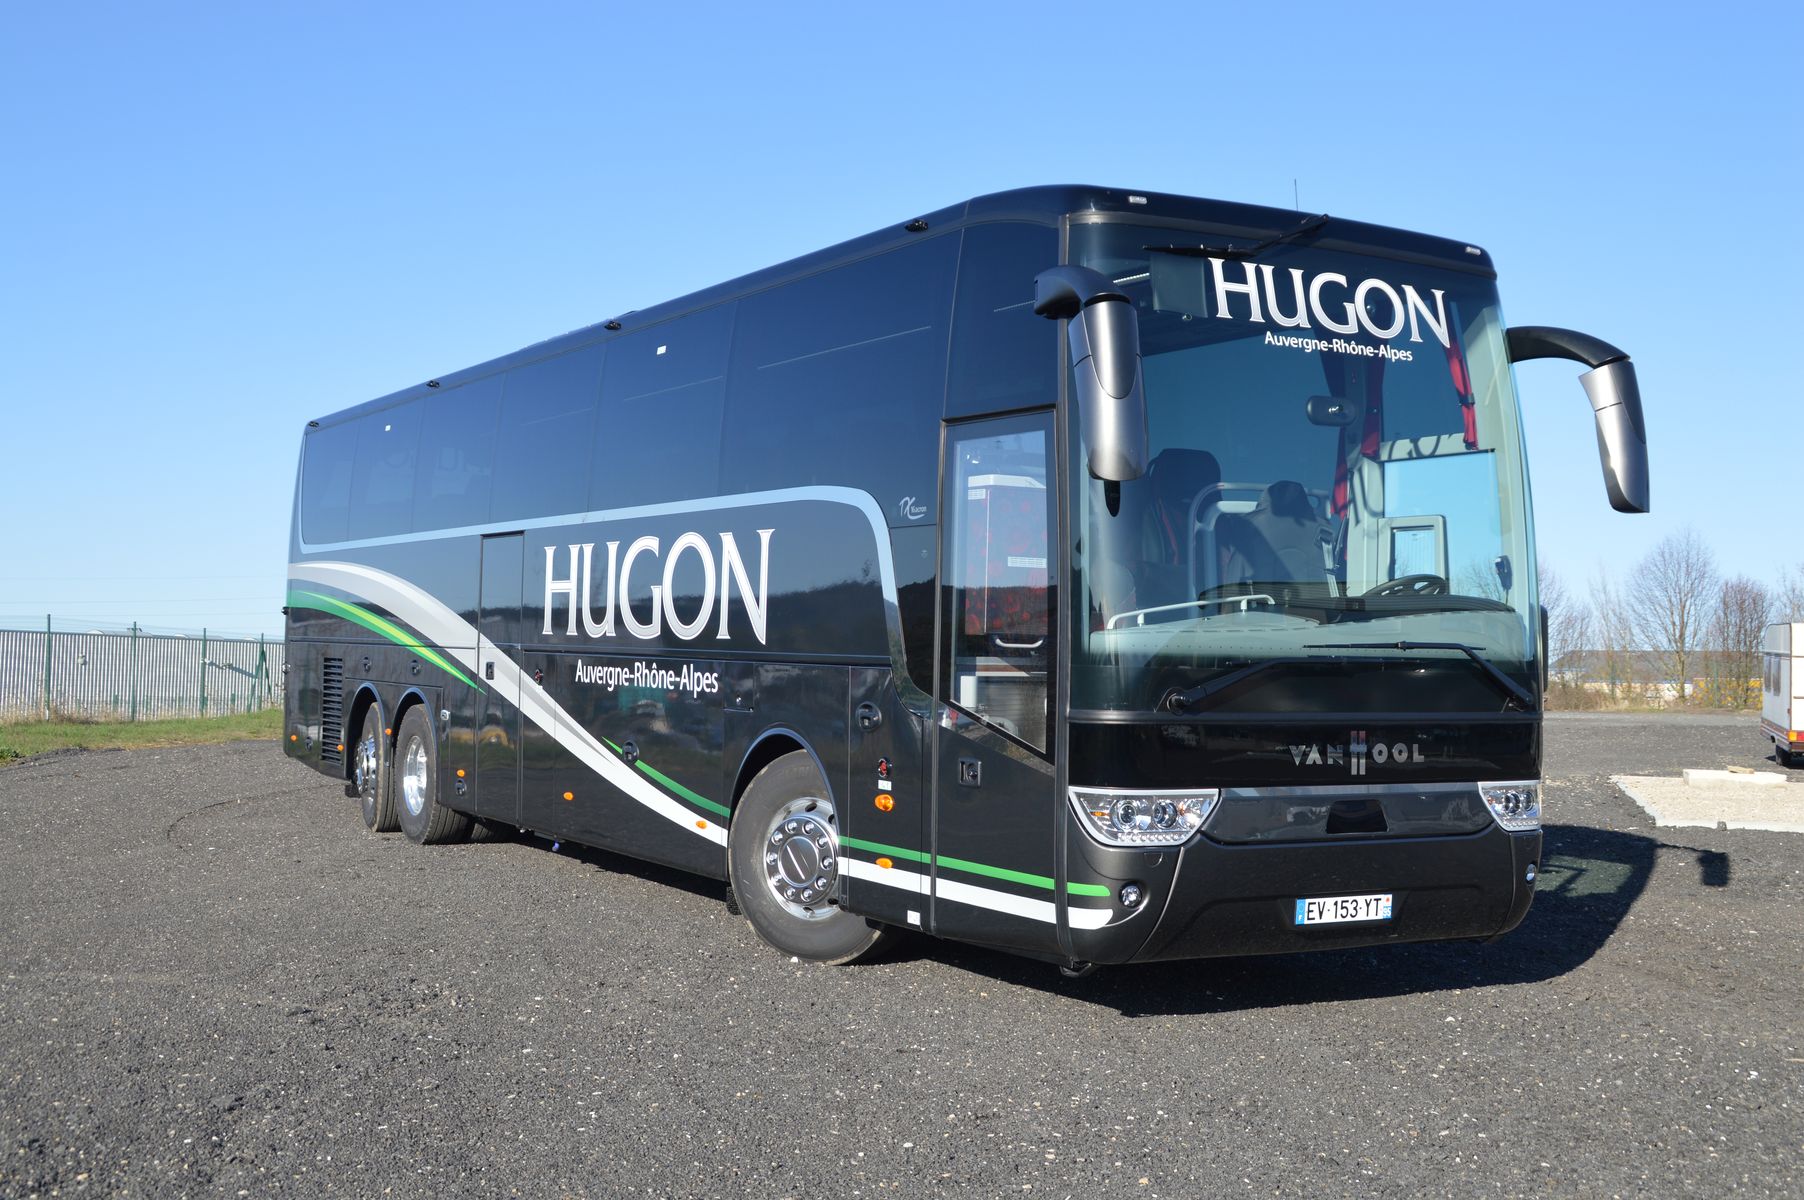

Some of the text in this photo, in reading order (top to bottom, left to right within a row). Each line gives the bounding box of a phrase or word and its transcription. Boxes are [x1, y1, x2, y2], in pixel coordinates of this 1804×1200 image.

[1207, 257, 1450, 348] HUGON
[1265, 331, 1413, 362] Auvergne-Rhône-Alpes
[542, 528, 776, 645] HUGON
[575, 659, 719, 698] Auvergne-Rhône-Alpes
[1288, 743, 1344, 766] VAN
